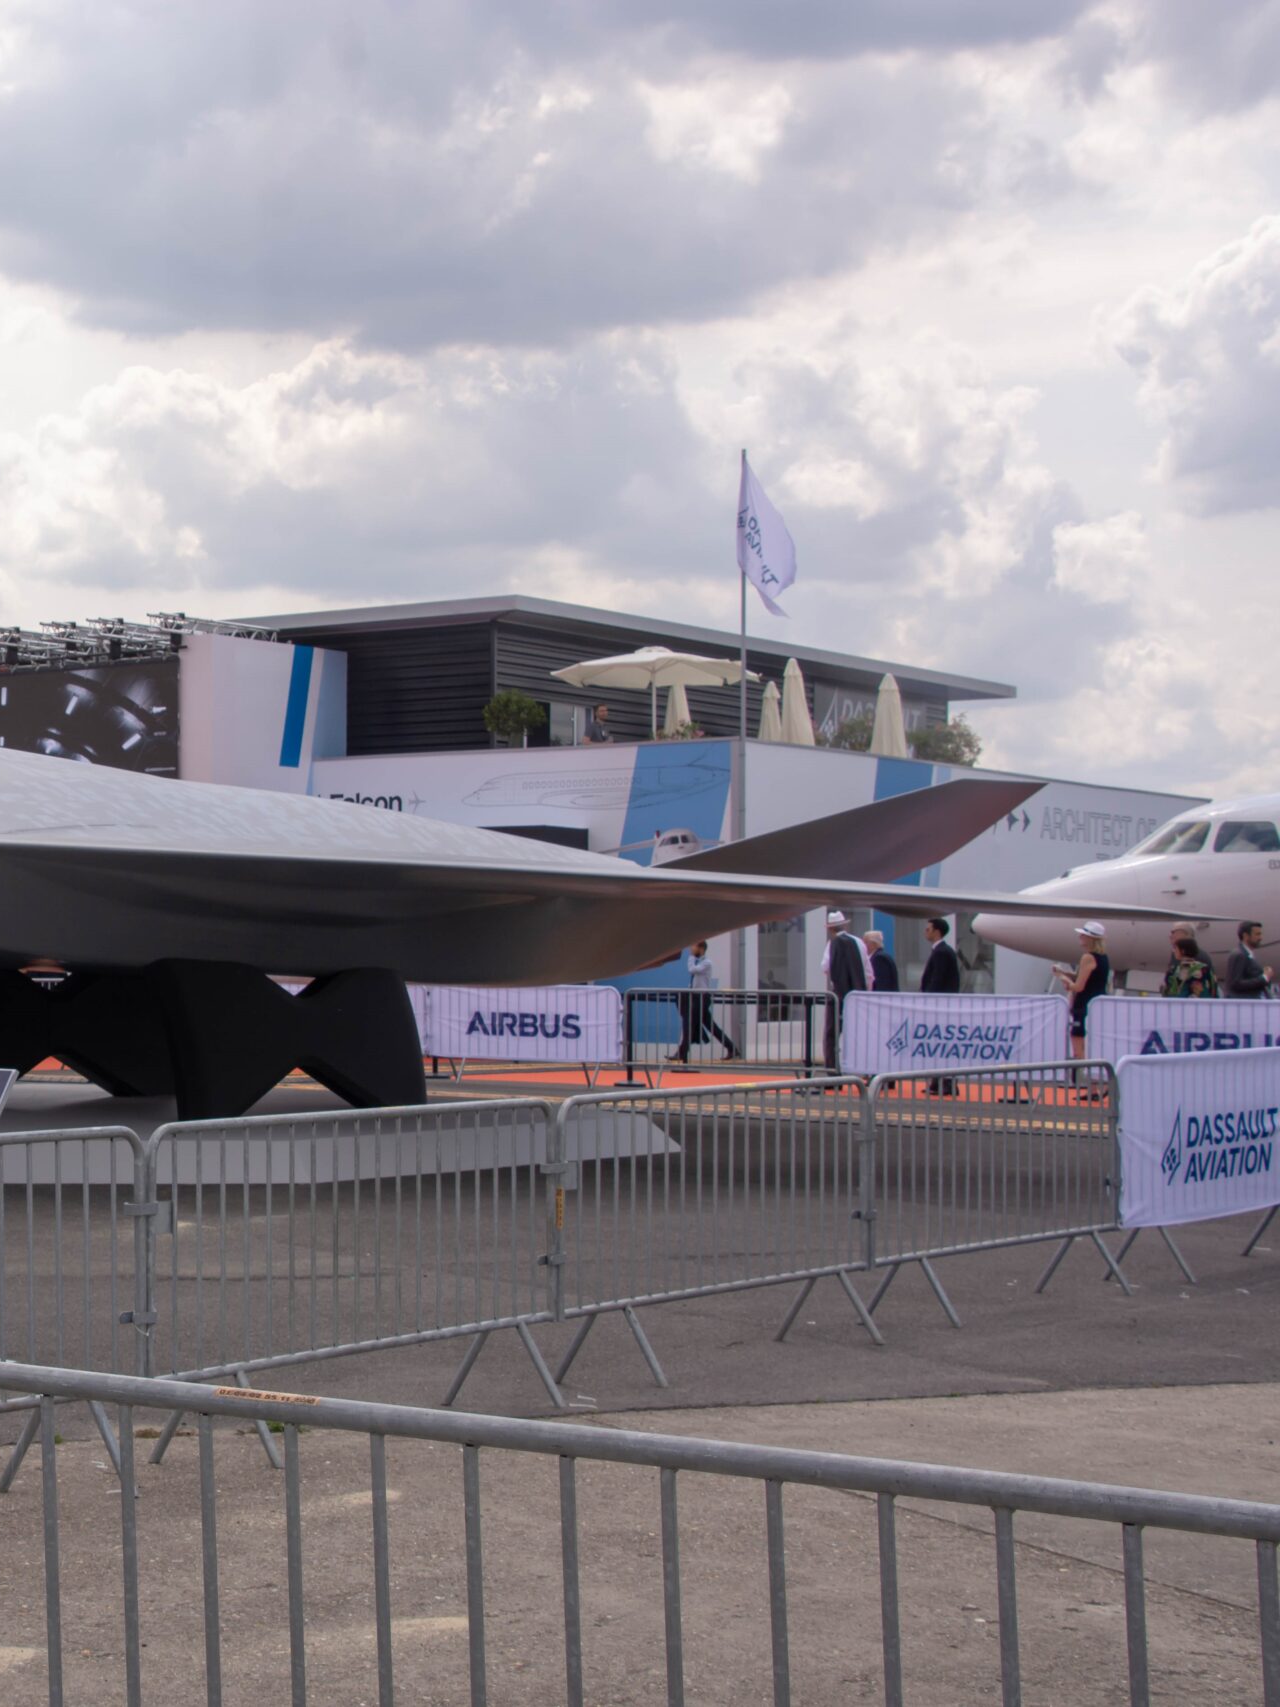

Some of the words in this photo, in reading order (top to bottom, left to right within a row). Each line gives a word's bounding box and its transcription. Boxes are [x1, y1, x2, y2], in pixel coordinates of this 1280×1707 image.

[1040, 806, 1132, 847] ARCHITECT
[466, 1011, 581, 1039] AIRBUS
[913, 1023, 1022, 1042] DASSAULT
[912, 1042, 1013, 1060] AVIATION
[1186, 1107, 1278, 1148] DASSAULT
[1184, 1142, 1272, 1184] AVIATION
